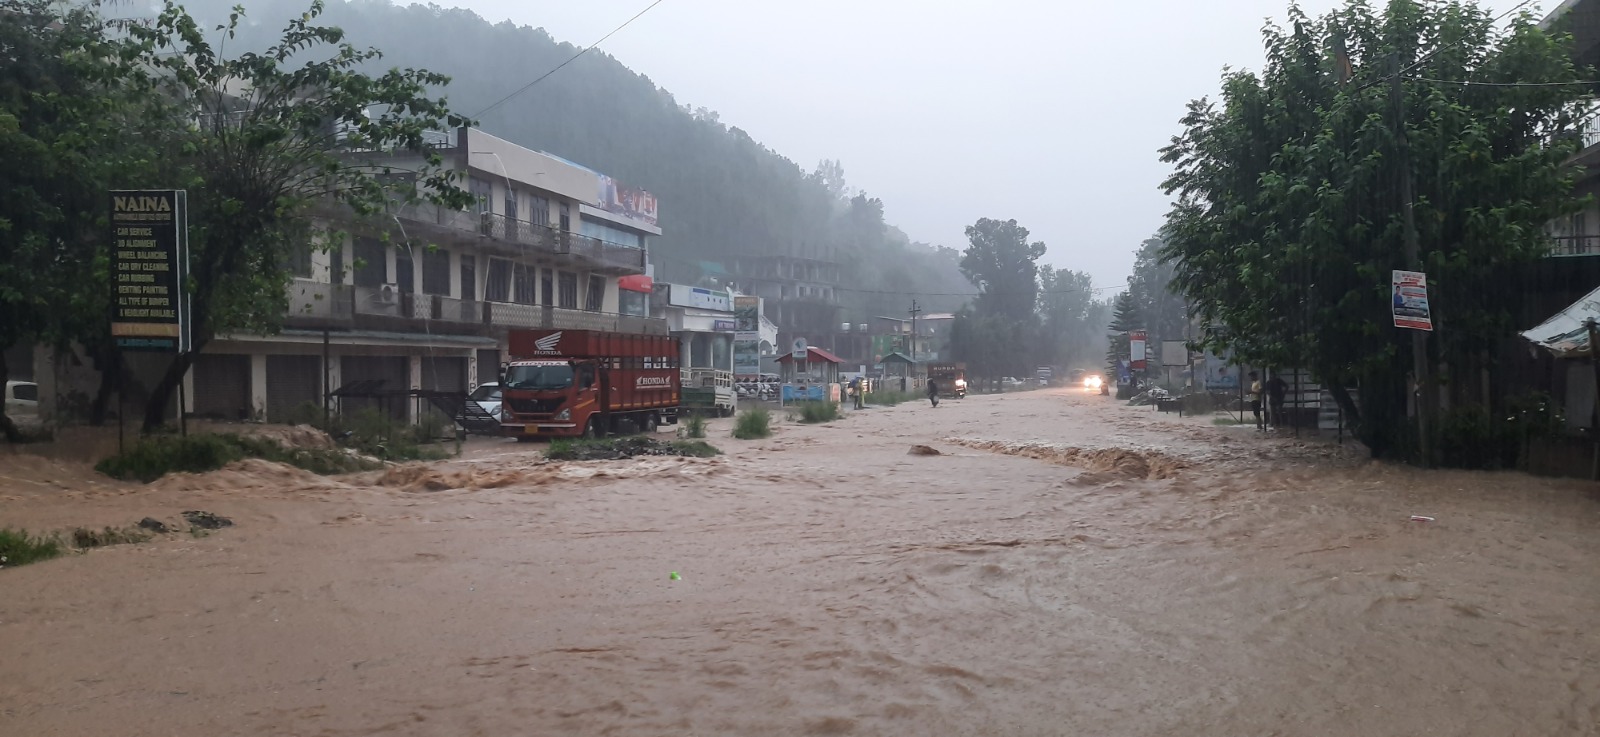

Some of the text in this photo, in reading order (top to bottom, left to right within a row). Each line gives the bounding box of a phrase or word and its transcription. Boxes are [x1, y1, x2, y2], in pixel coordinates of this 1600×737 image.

[114, 196, 170, 211] NAINA
[130, 228, 152, 236] SERVICE
[118, 262, 129, 270] CAR
[142, 263, 169, 271] CLEANING
[128, 297, 140, 305] TYPE
